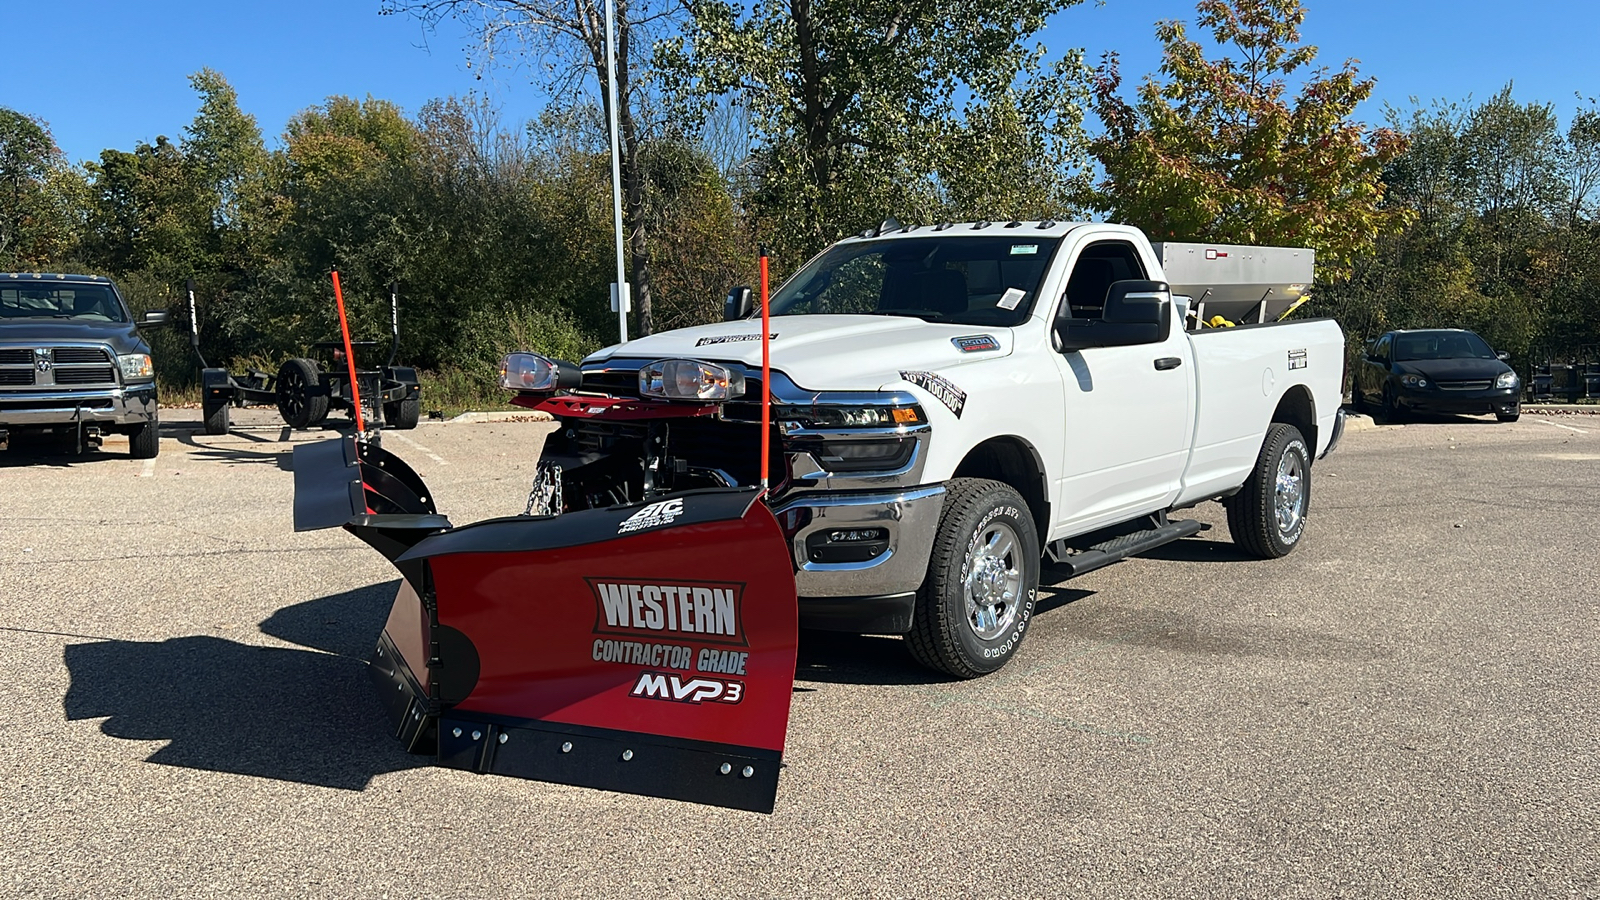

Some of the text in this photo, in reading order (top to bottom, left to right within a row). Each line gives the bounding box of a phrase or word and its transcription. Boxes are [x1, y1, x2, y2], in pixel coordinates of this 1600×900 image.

[627, 498, 684, 521] BTC
[597, 583, 737, 636] WESTERN
[592, 638, 749, 676] CONTRACTOR GRADE
